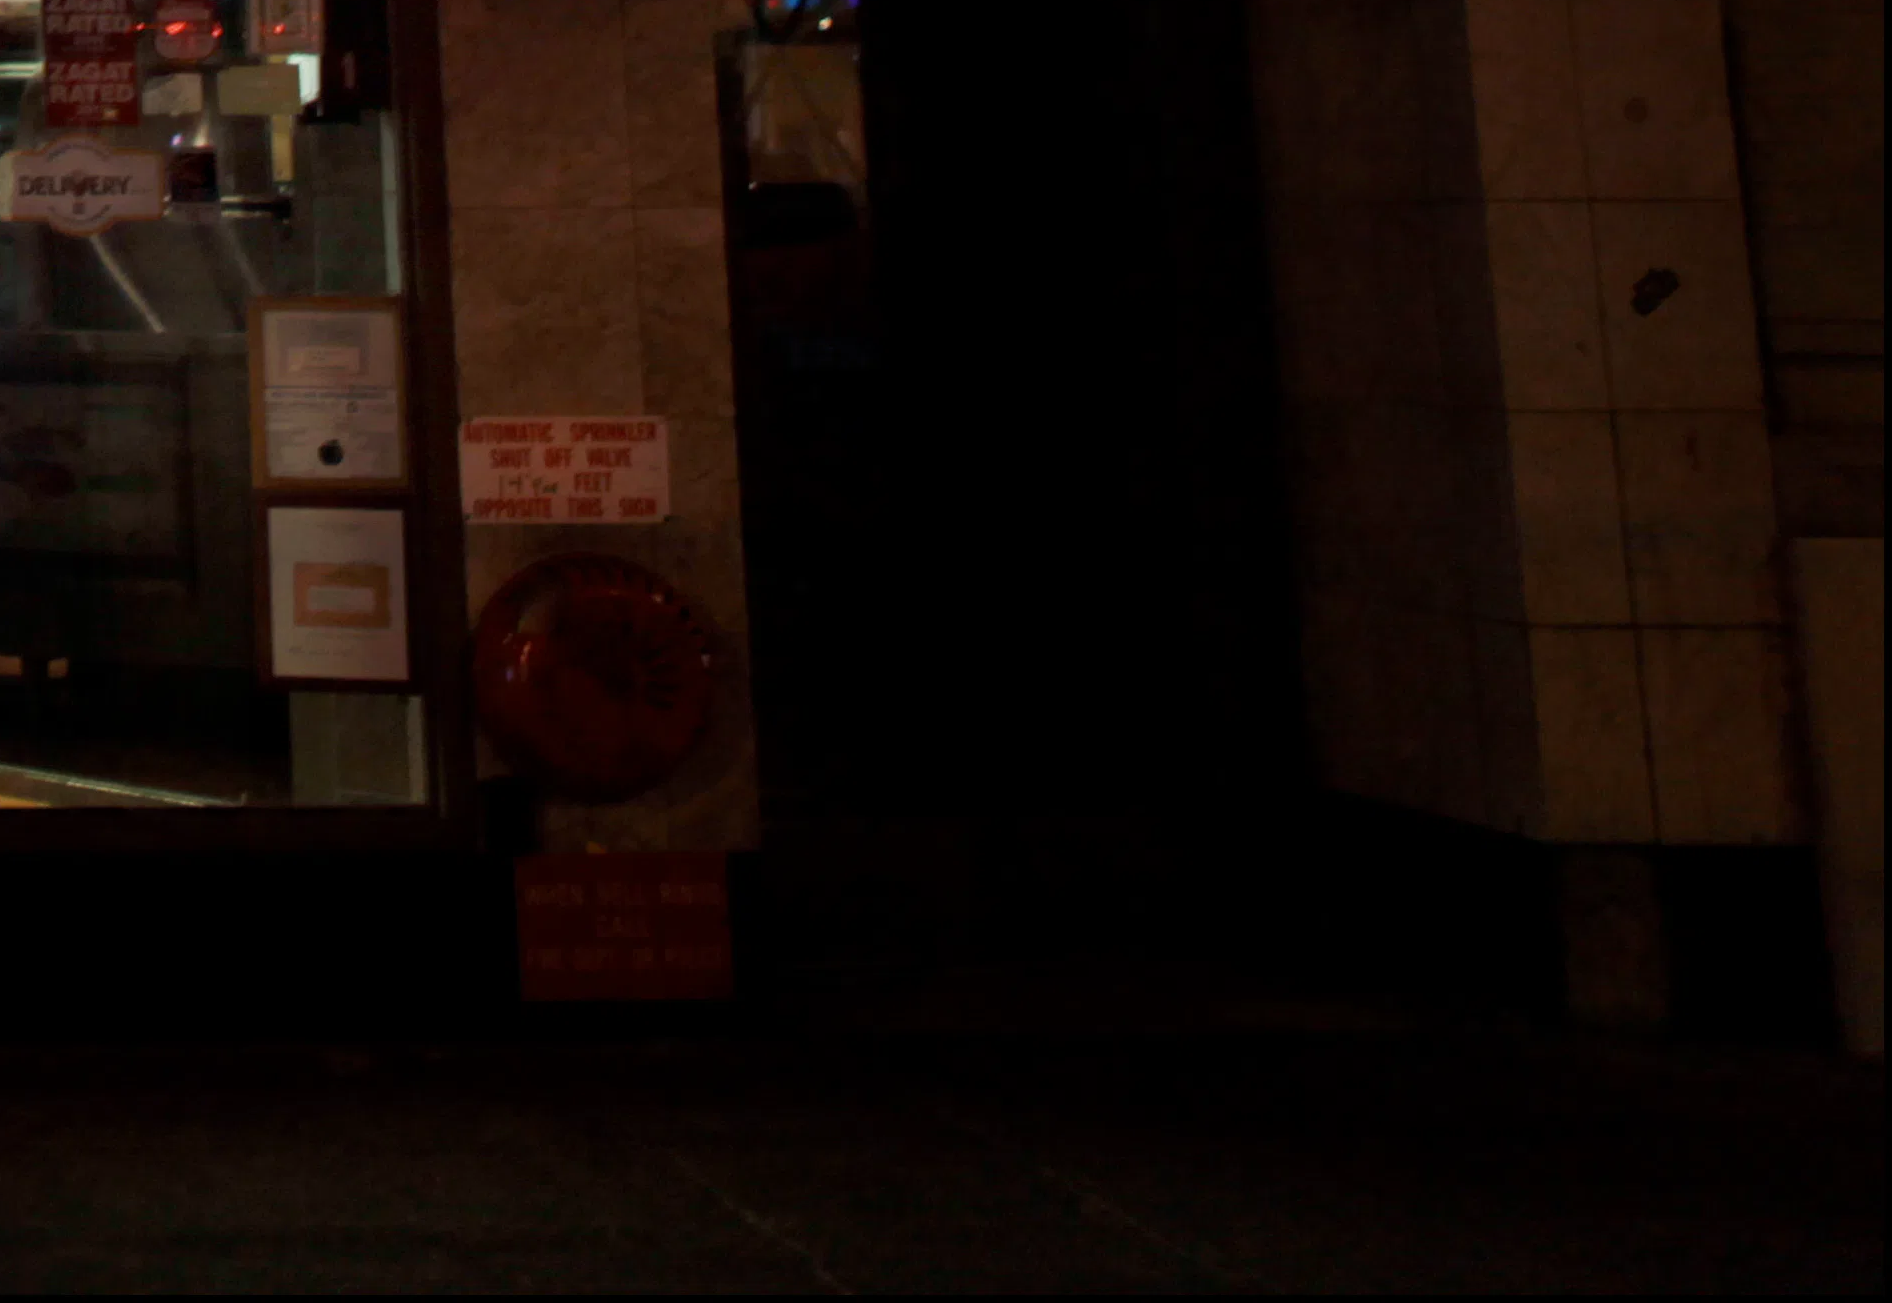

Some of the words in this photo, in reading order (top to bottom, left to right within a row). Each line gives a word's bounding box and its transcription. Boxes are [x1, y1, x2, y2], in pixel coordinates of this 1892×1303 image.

[463, 422, 555, 443] AUTOMATIC
[569, 422, 657, 442] SPRINKLER
[489, 447, 532, 469] SHUT
[543, 447, 573, 469] OFF
[585, 447, 632, 468] VALVE
[573, 471, 613, 493] FEET
[472, 497, 553, 519] OPPOSITE
[568, 497, 604, 518] THIS
[618, 497, 657, 517] SIGN
